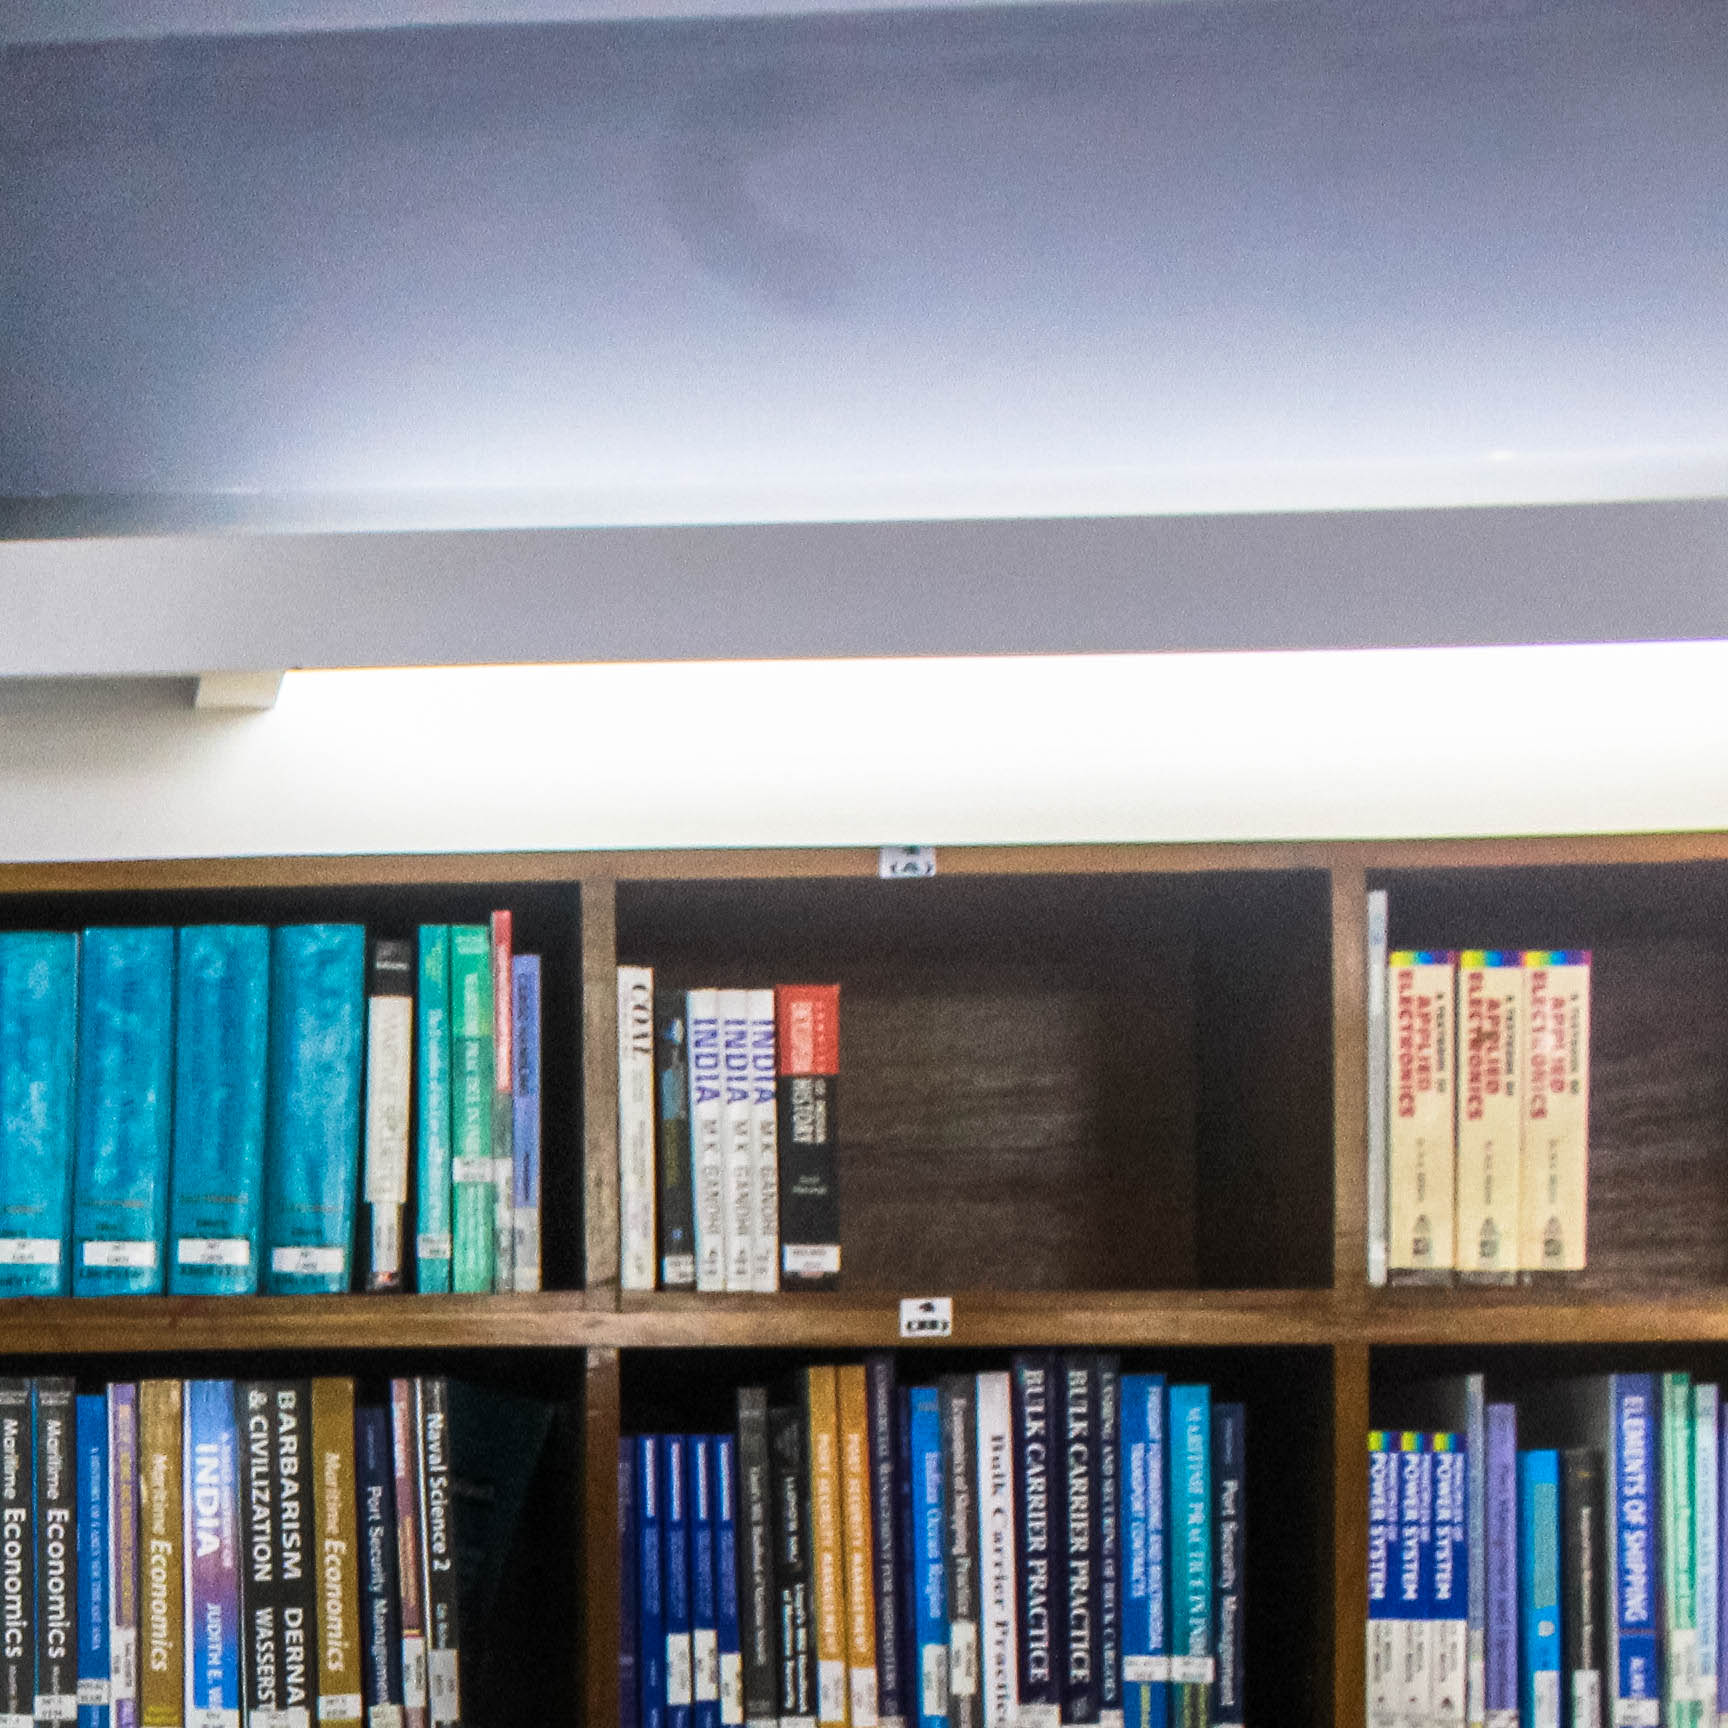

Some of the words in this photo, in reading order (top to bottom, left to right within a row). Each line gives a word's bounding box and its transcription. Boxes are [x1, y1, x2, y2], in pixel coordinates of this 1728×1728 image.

[695, 1018, 720, 1104] INDIA
[725, 1018, 749, 1104] INDIA
[753, 1018, 775, 1104] INDIA
[248, 1390, 267, 1409] &
[1023, 1369, 1046, 1437] BULK
[1068, 1369, 1089, 1437] BULK
[3, 1418, 19, 1499] Maritime
[46, 1419, 62, 1499] Maritime
[426, 1413, 448, 1473] Naval
[1623, 1396, 1650, 1496] ELEMENTS
[151, 1453, 168, 1534] Maritime
[195, 1443, 221, 1557] INDIA
[249, 1415, 273, 1582] CIVILIZATION
[278, 1391, 302, 1580] BARBARISM
[324, 1452, 341, 1534] Maritime
[367, 1486, 384, 1522] Port
[429, 1479, 449, 1555] Science
[1026, 1443, 1047, 1552] CARRIER
[1069, 1443, 1090, 1552] CARRIER
[1370, 1454, 1386, 1520] POWER
[1403, 1454, 1419, 1520] POWER
[1436, 1454, 1453, 1520] POWER
[1625, 1500, 1648, 1525] OF
[4, 1508, 26, 1658] Economics
[47, 1508, 70, 1658] Economics
[368, 1526, 385, 1592] Security
[432, 1560, 451, 1571] 2
[1370, 1524, 1386, 1600] SYSTEM
[1403, 1524, 1419, 1600] SYSTEM
[1436, 1524, 1453, 1600] SYSTEM
[1625, 1530, 1650, 1622] SHIPPING
[151, 1539, 172, 1672] Economics
[324, 1539, 348, 1672] Economics
[1028, 1560, 1049, 1683] PRACTICE
[1070, 1560, 1090, 1684] PRACTICE
[370, 1599, 390, 1704] Managemen
[1221, 1595, 1238, 1707] Management
